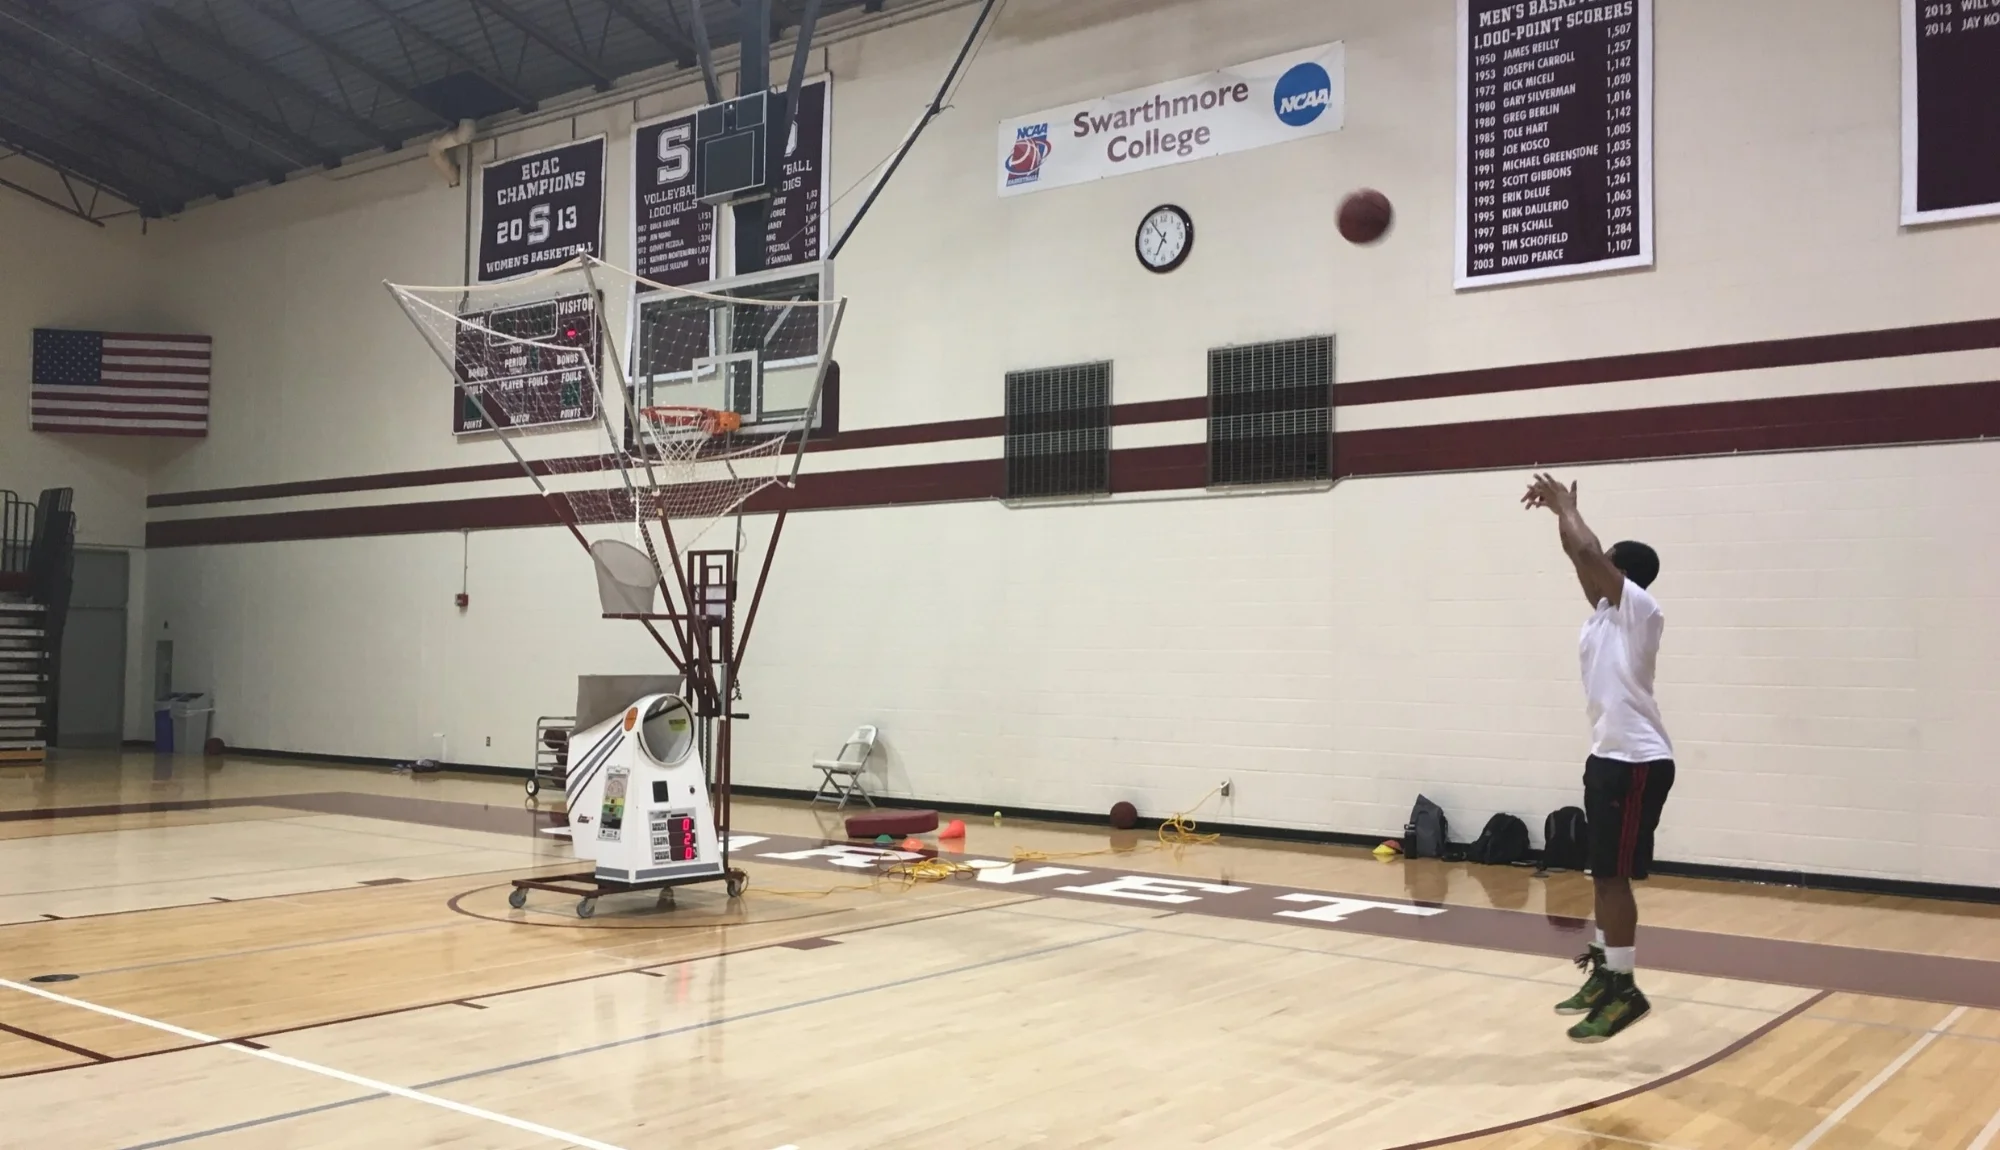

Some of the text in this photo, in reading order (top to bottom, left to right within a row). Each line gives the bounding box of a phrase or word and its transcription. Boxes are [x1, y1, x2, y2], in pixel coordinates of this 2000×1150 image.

[1479, 3, 1525, 27] MEN'S
[1566, 0, 1633, 28] SCORERS
[1925, 3, 1952, 19] 2013
[1925, 21, 1952, 37] 2014
[1961, 16, 1981, 31] JAY
[1475, 24, 1631, 66] 1950 JAMES REILLY 1,507
[1475, 69, 1496, 82] 1953
[1503, 61, 1535, 76] JOSEPH
[1537, 52, 1575, 68] CARROLL
[1476, 57, 1631, 97] 1972 RICK MICELI 1,142
[1279, 88, 1329, 115] NCAA
[1475, 73, 1631, 113] 1980 GARY SILVERMAN 1,020
[1073, 82, 1249, 138] Swarthmore
[1475, 90, 1631, 129] 1980 GREG BERLIN 1,016
[1017, 122, 1048, 140] NCAA
[1475, 107, 1631, 145] 1985 TOLE HART 1,142
[1475, 123, 1631, 160] 1988 JOE KOSCO 1,005
[657, 122, 691, 184] S
[1107, 125, 1211, 163] College
[1475, 140, 1631, 176] 1991 MICHAEL GREENSTONE 1,035
[521, 157, 560, 180] ECAC
[1475, 157, 1631, 191] 1992 SCOTT GIBBONS 1,563
[497, 171, 585, 206] CHAMPIONS
[644, 184, 696, 205] VOLLEYBAL
[1475, 195, 1495, 207] 1993
[1502, 191, 1522, 203] ERIK
[1607, 173, 1630, 187] 1,261
[672, 200, 697, 213] KILLS
[1474, 190, 1632, 223] 1995 KIRK DAULERIO 1,063
[496, 203, 577, 246] 20 S 13
[1474, 207, 1632, 238] 1997 BEN SCHALL 1,075
[1474, 223, 1632, 254] 1999 TIM SCHOFIELD 1,284
[486, 254, 529, 273] WOMEN'S
[1474, 240, 1632, 270] 2003 DAVID PEARCE 1,107
[683, 818, 690, 831] 0
[684, 833, 691, 845] 2
[685, 847, 692, 859] 0
